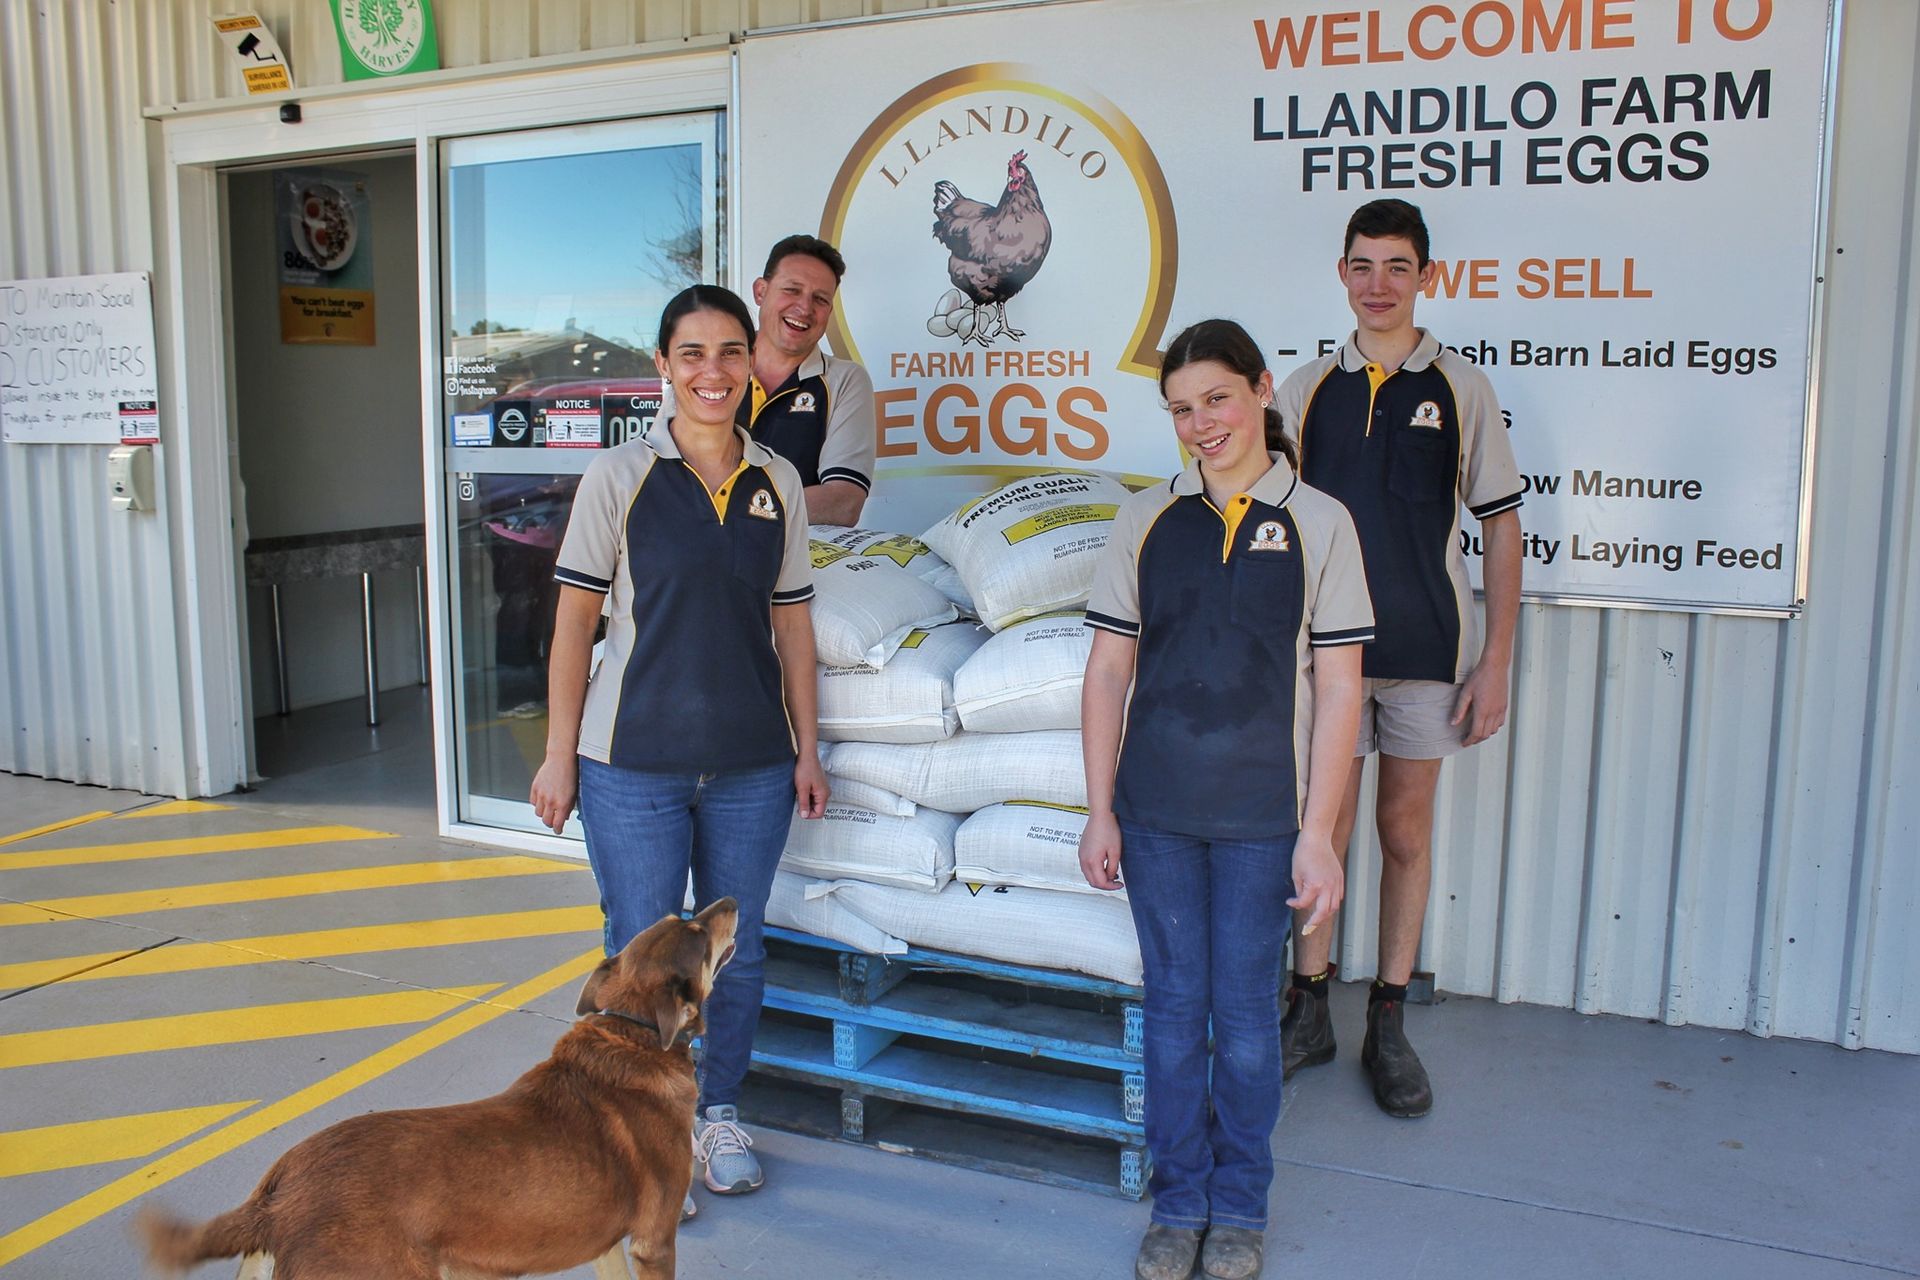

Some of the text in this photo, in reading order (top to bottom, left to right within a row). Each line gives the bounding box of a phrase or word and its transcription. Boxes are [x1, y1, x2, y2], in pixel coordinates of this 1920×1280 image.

[1253, 0, 1636, 70] WELCOME
[361, 38, 414, 67] HARVEST
[1253, 69, 1771, 141] LLANDILO FARM
[879, 105, 1107, 188] LLANDILO
[1302, 131, 1710, 192] FRESH EGGS
[1424, 257, 1652, 299] WE SELL
[25, 345, 146, 386] CUSTOMERS
[459, 363, 496, 374] Facebook
[890, 350, 1090, 378] FARM FRESH
[1510, 339, 1589, 367] Barn
[1601, 340, 1675, 368] Laid
[1687, 340, 1777, 375] Eggs
[459, 384, 497, 400] Instagram
[555, 399, 591, 409] NOTICE
[630, 396, 662, 409] Come
[874, 382, 1110, 461] EGGS
[1572, 469, 1703, 500] Manure
[962, 485, 1030, 529] PREMIUM
[988, 492, 1042, 515] LAYING
[1046, 484, 1090, 496] MASH
[1053, 544, 1067, 553] NOT
[1054, 542, 1106, 560] RUMINANT ANIMA
[1571, 534, 1683, 572] Laying
[1696, 539, 1783, 570] Feed
[1024, 633, 1057, 642] RUMINANT
[823, 670, 853, 678] RUMINANT
[851, 816, 877, 825] ANIMALS
[1064, 831, 1077, 839] FED
[1026, 832, 1080, 847] RUMINANT ANIMA
